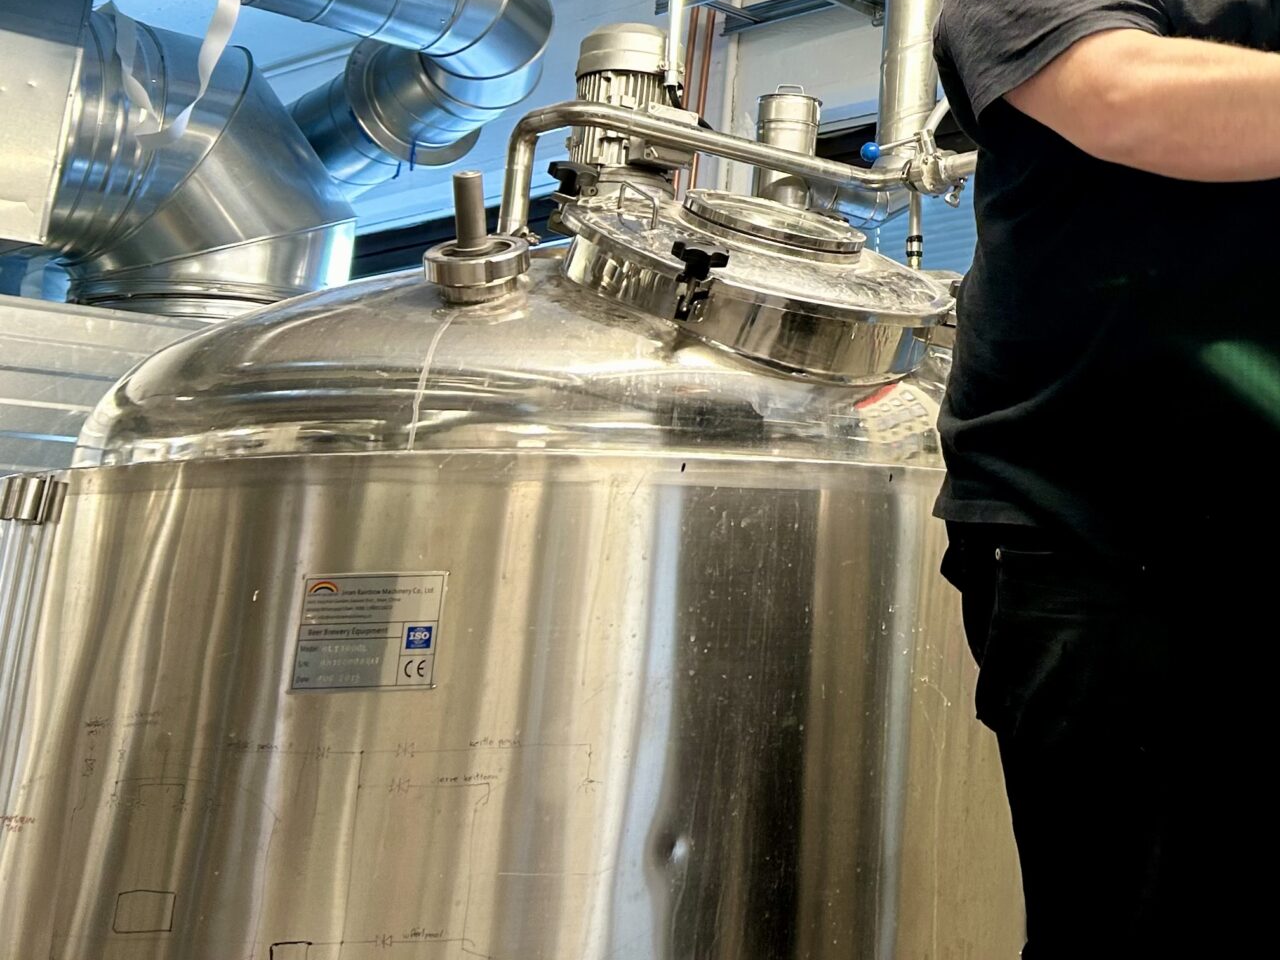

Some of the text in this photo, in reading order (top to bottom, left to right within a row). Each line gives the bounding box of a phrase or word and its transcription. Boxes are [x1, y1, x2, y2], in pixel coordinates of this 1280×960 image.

[357, 588, 381, 596] Rainbow
[382, 587, 411, 596] Machinery
[308, 627, 388, 637] Beer Brewery Equipment
[409, 631, 430, 640] ISO
[404, 659, 427, 678] CE
